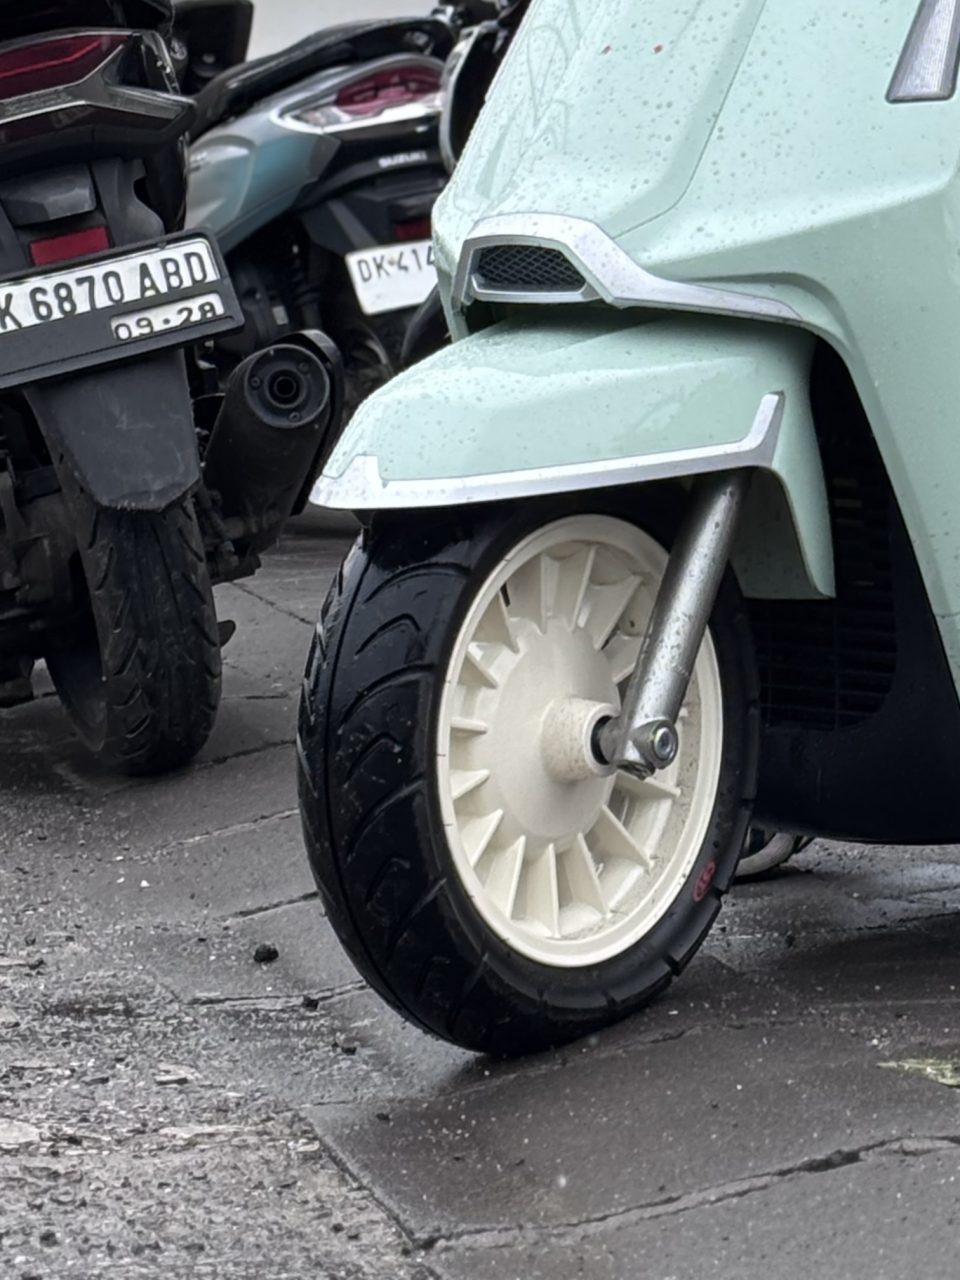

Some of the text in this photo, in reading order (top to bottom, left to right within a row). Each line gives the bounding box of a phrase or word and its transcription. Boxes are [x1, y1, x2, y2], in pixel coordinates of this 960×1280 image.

[30, 270, 125, 322] 6870
[138, 252, 208, 299] ABD
[357, 255, 391, 283] DK
